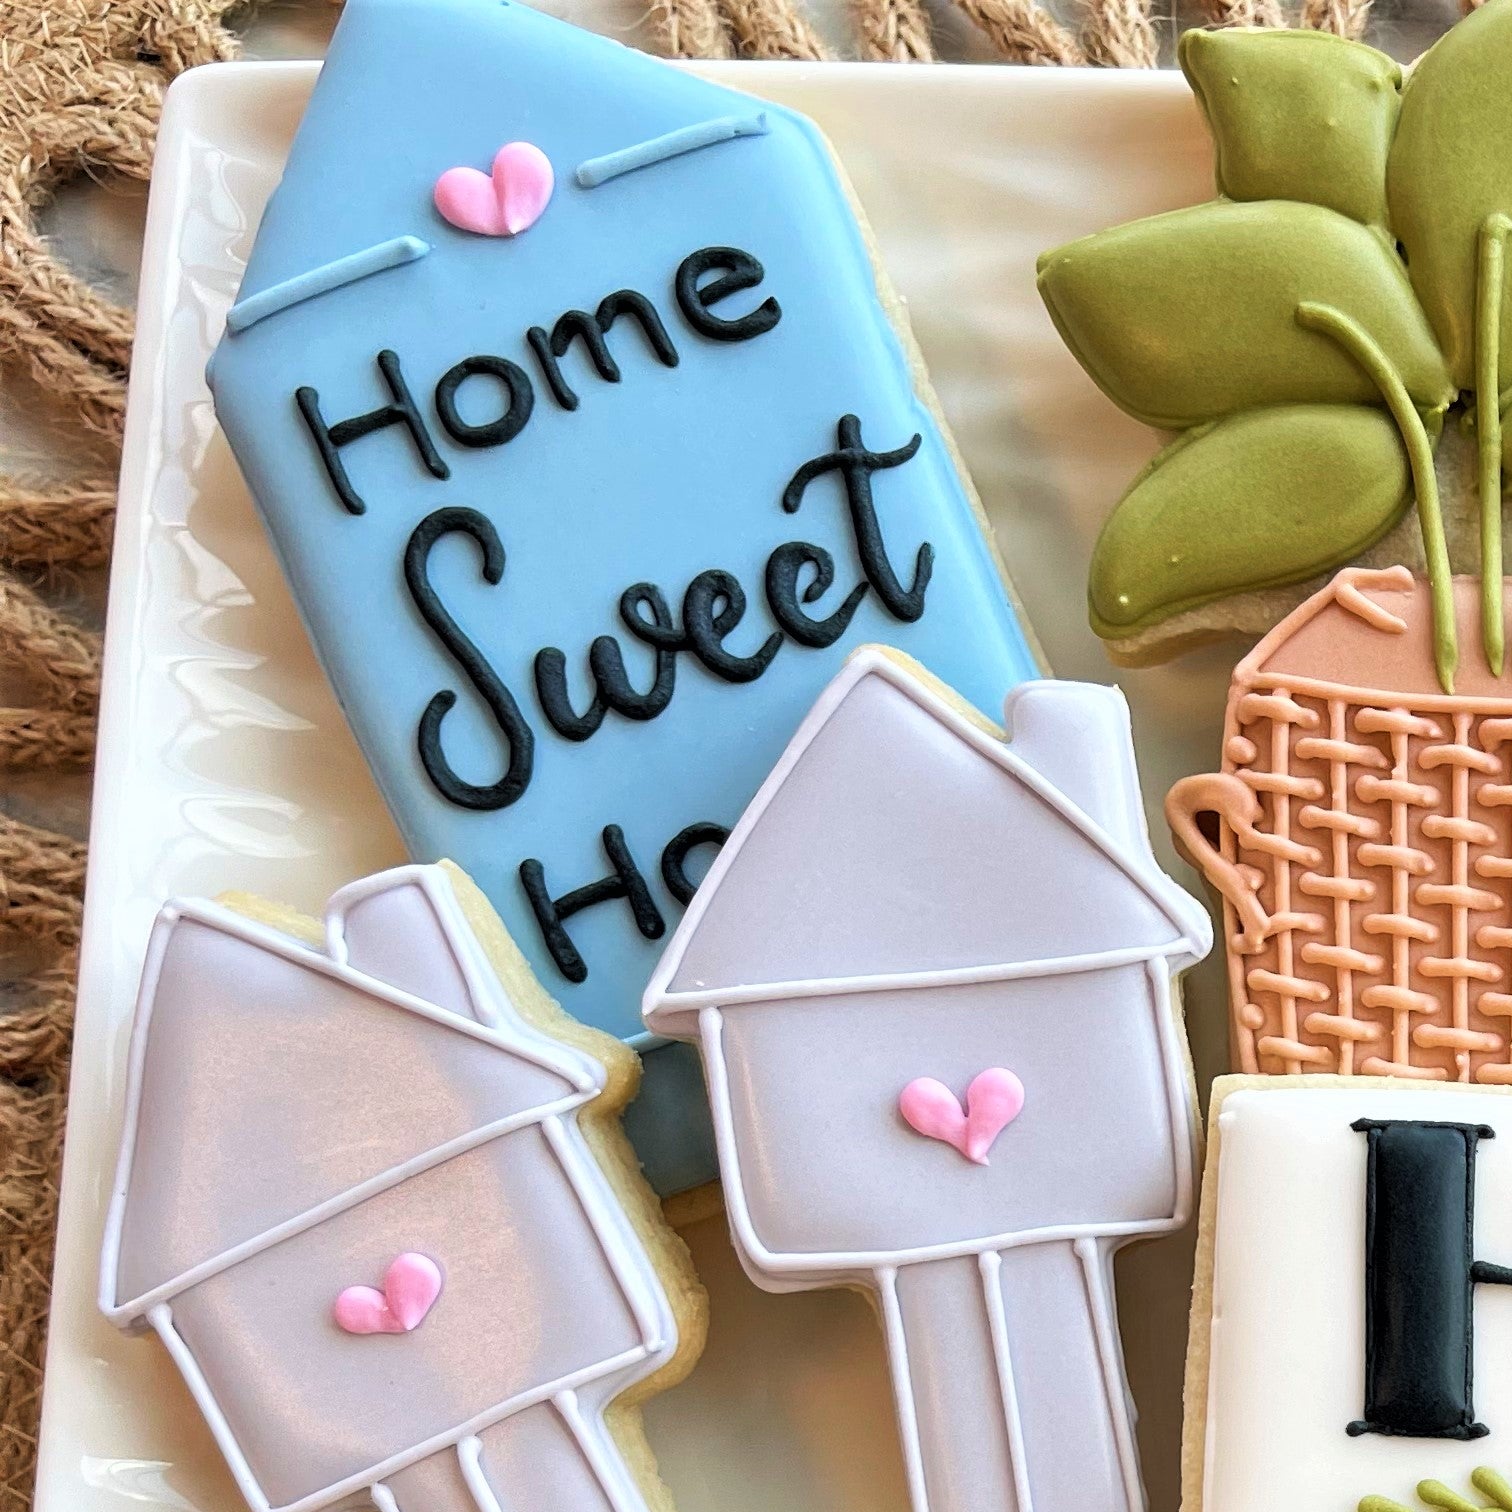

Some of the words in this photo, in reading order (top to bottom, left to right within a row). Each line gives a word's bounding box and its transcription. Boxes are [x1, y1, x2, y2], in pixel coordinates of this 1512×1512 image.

[294, 246, 782, 515] Home
[402, 414, 935, 812] Sweet
[519, 821, 733, 984] Ho
